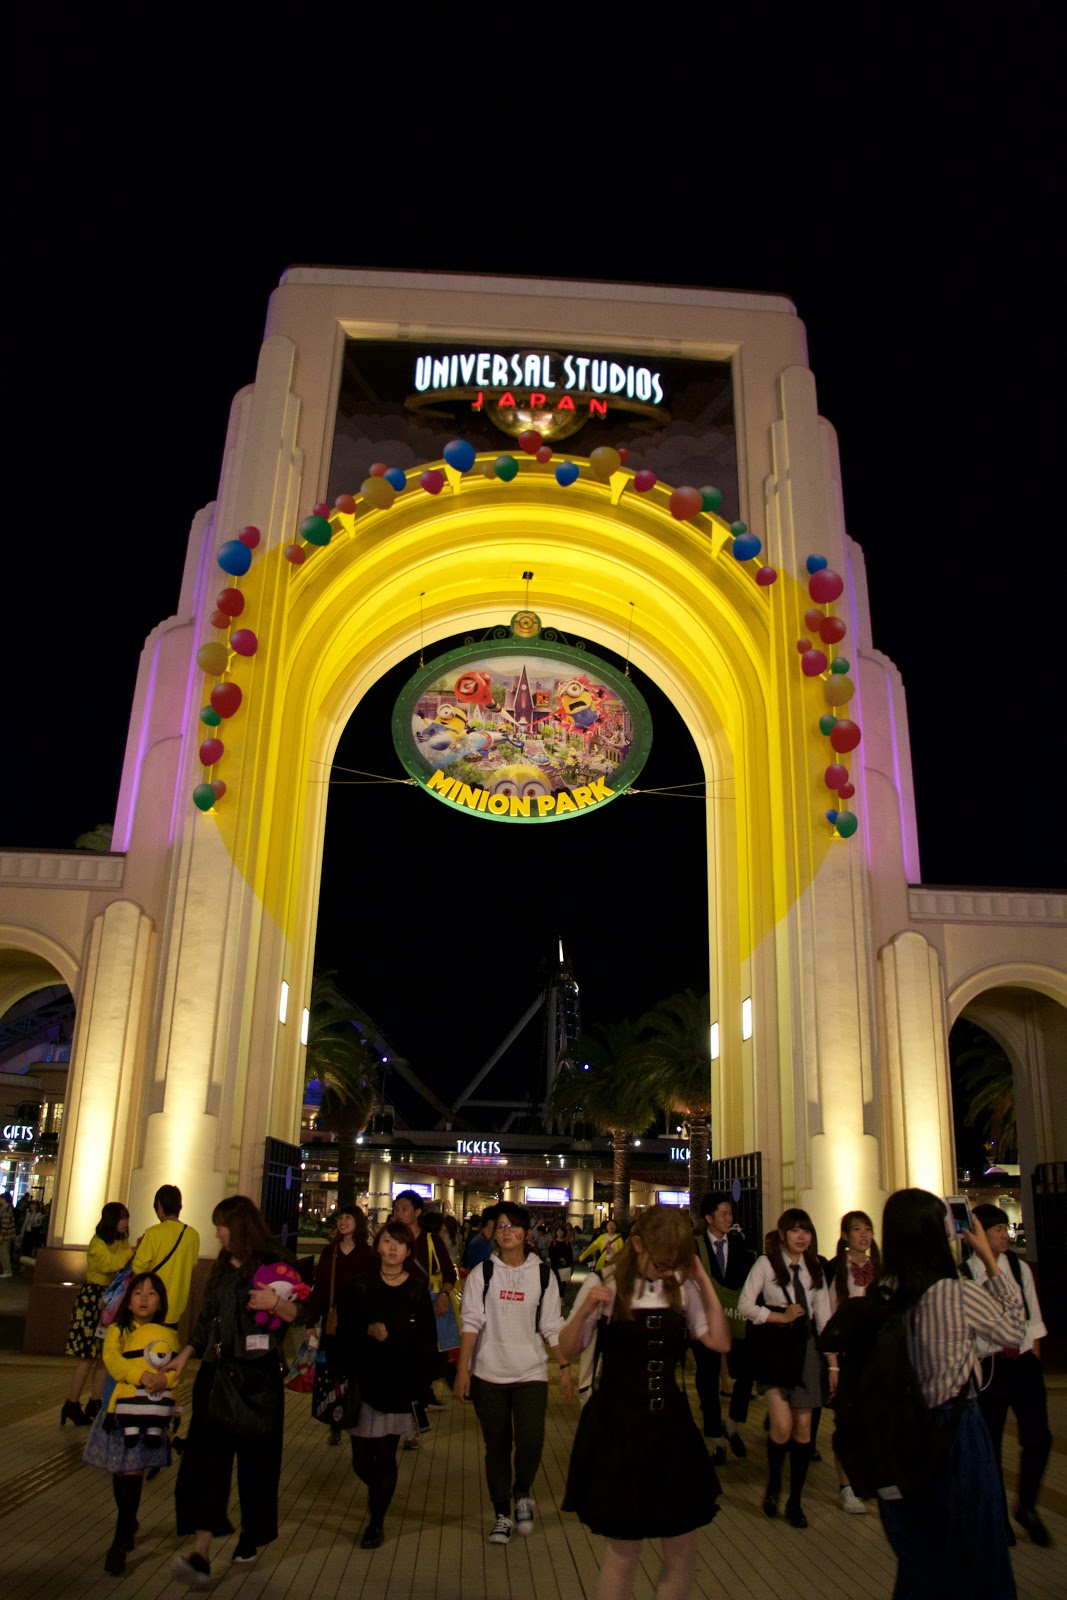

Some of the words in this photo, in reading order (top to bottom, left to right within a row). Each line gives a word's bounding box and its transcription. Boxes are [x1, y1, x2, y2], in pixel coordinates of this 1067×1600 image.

[415, 353, 556, 391] UNIVERSAL
[564, 355, 663, 404] STUDIOS
[471, 391, 607, 415] JAPAN
[426, 769, 531, 817] MINION
[537, 775, 616, 817] PARK
[3, 1125, 33, 1140] GIFTS
[457, 1140, 501, 1154] TICKETS
